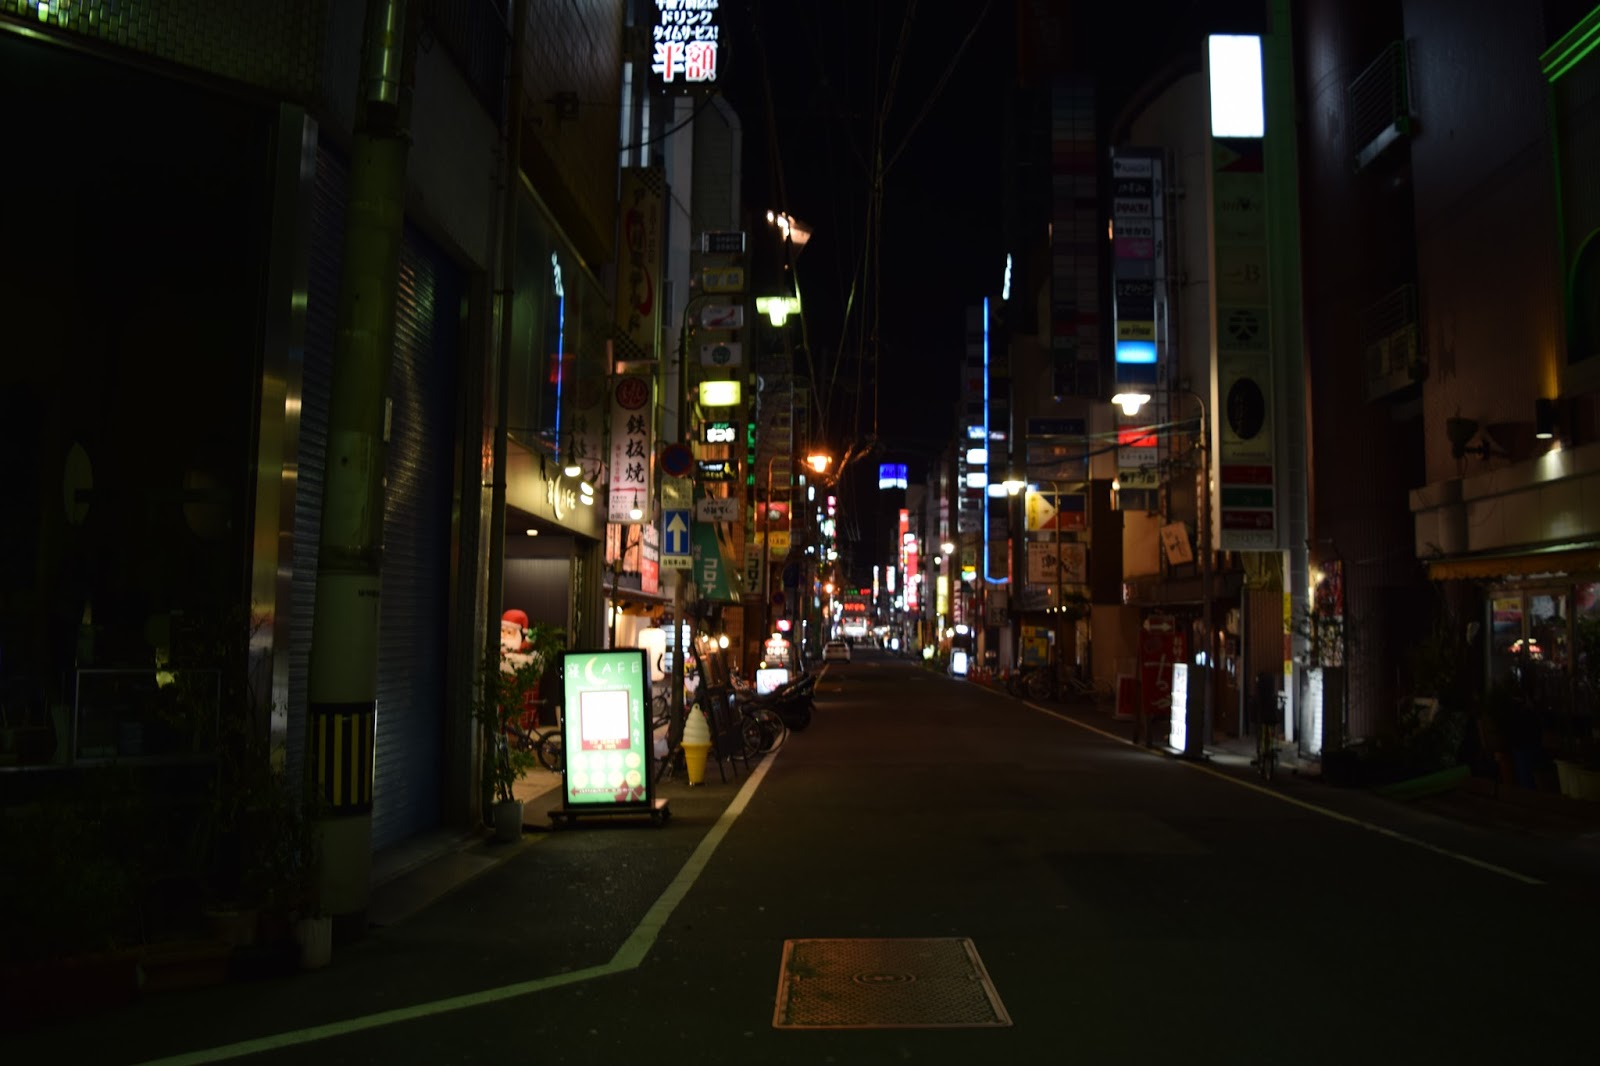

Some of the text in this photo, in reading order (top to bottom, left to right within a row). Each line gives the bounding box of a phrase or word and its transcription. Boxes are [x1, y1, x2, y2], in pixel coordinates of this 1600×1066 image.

[661, 10, 712, 26] ドリンク
[651, 40, 718, 82] 半額
[626, 414, 646, 483] 鉄板焼
[703, 557, 718, 595] コロナ
[748, 558, 759, 592] コロナ
